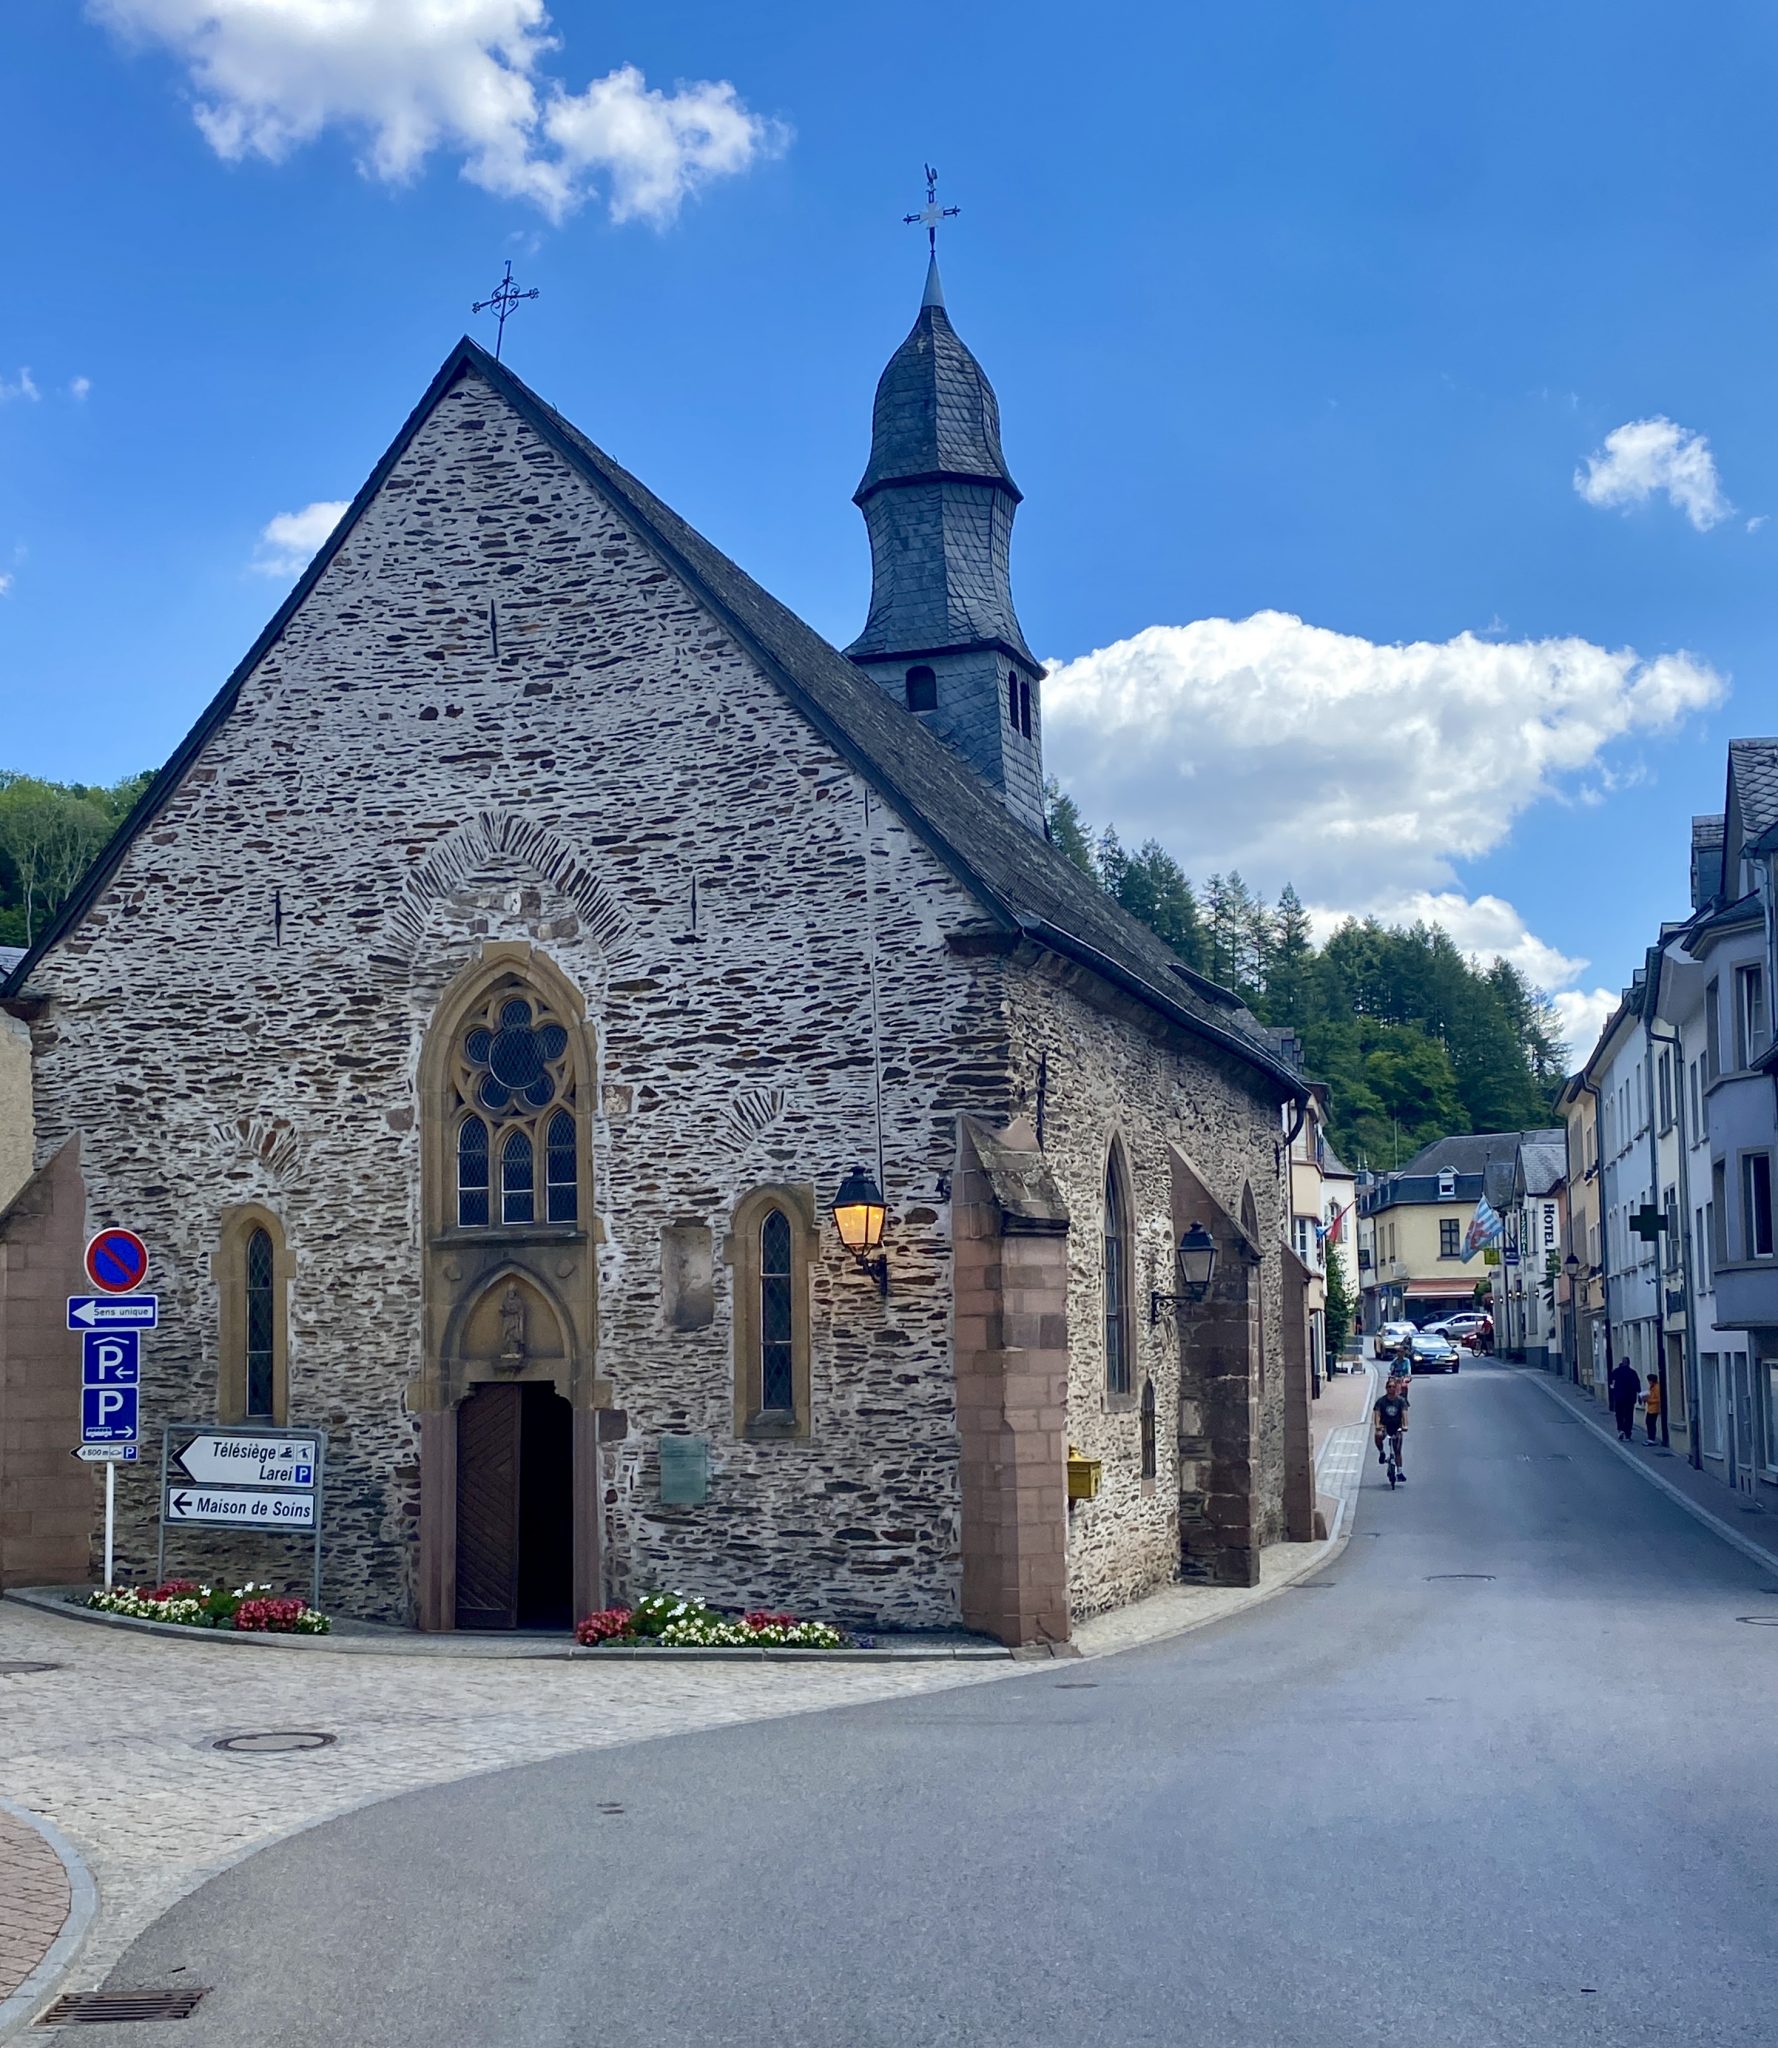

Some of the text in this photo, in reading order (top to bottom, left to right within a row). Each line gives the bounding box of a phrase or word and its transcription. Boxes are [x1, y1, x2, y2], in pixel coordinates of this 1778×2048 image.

[1543, 1203, 1555, 1245] HOTEL
[94, 1308, 148, 1317] Sens unique
[98, 1345, 124, 1380] P
[98, 1390, 124, 1426] P
[125, 1447, 135, 1458] P
[213, 1441, 276, 1463] Télésiège
[259, 1465, 309, 1481] Larei P
[196, 1497, 311, 1518] Maison de Soins
